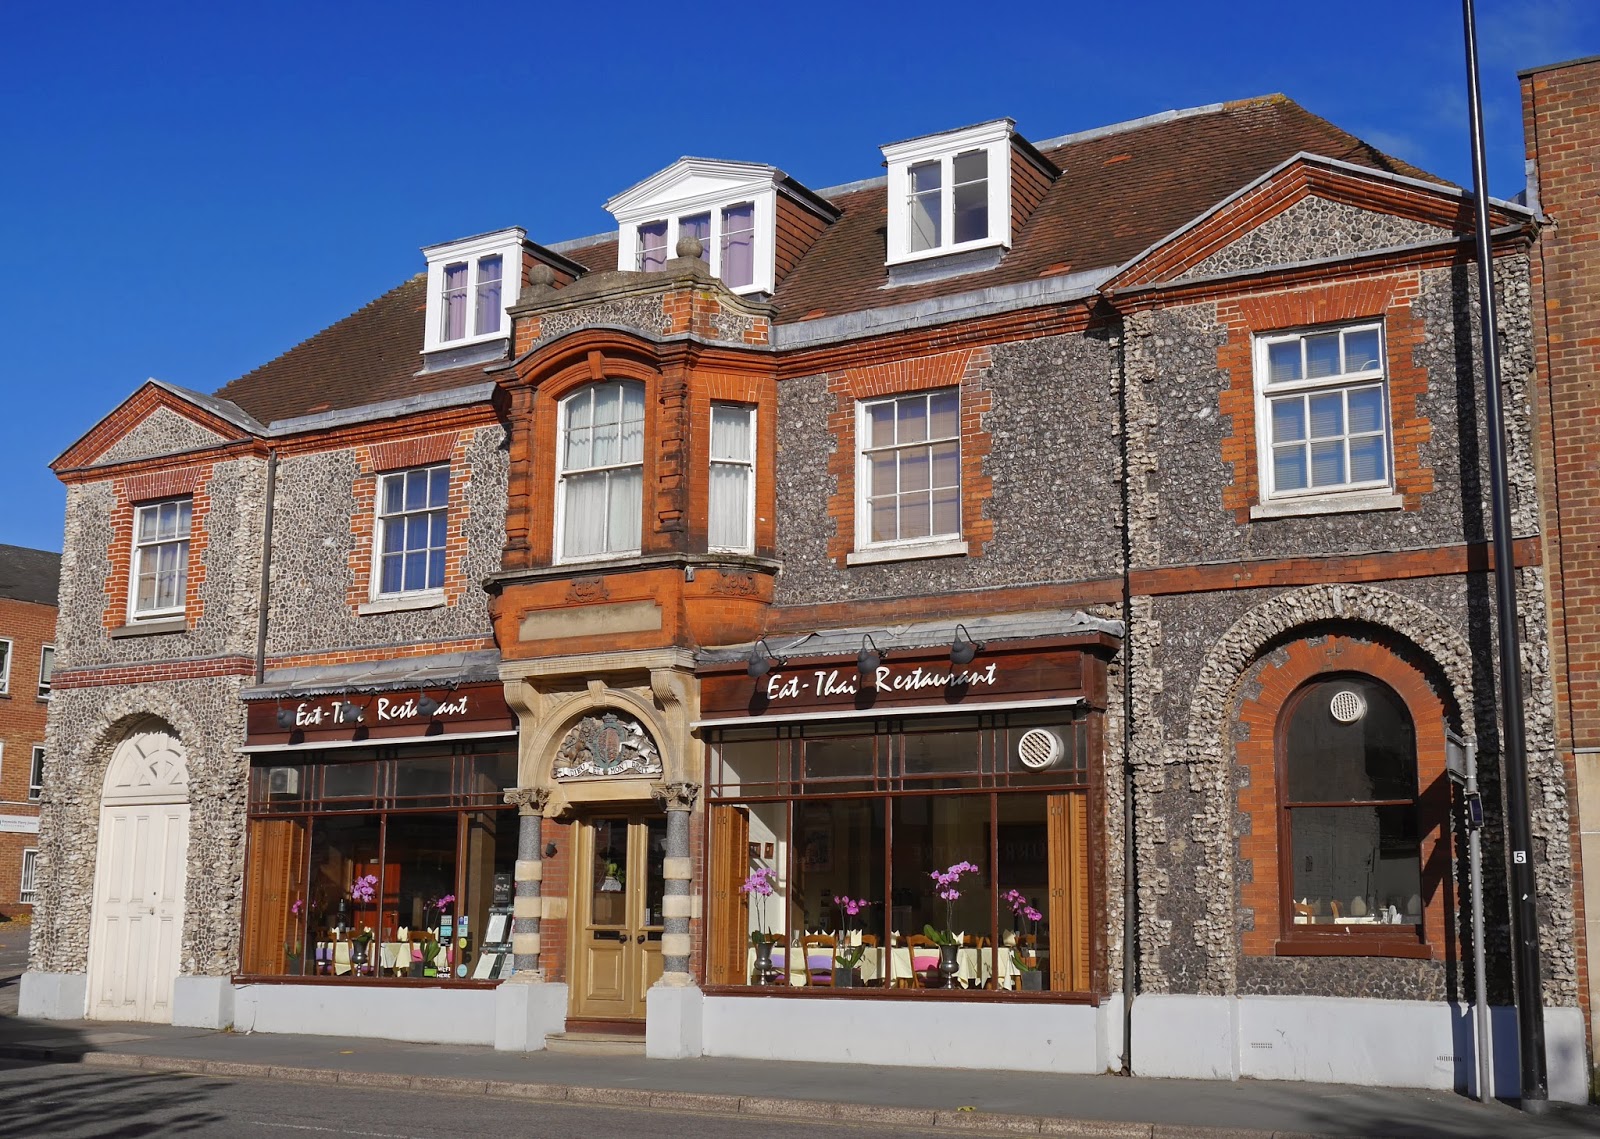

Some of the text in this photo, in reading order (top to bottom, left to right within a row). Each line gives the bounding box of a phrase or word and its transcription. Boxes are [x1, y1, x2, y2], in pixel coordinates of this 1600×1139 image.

[766, 662, 997, 700] Eat-Thai Restaurant
[295, 695, 467, 725] Eat-Ti Restant
[569, 763, 585, 777] DIEU
[610, 764, 624, 775] MON
[1516, 852, 1524, 863] 5
